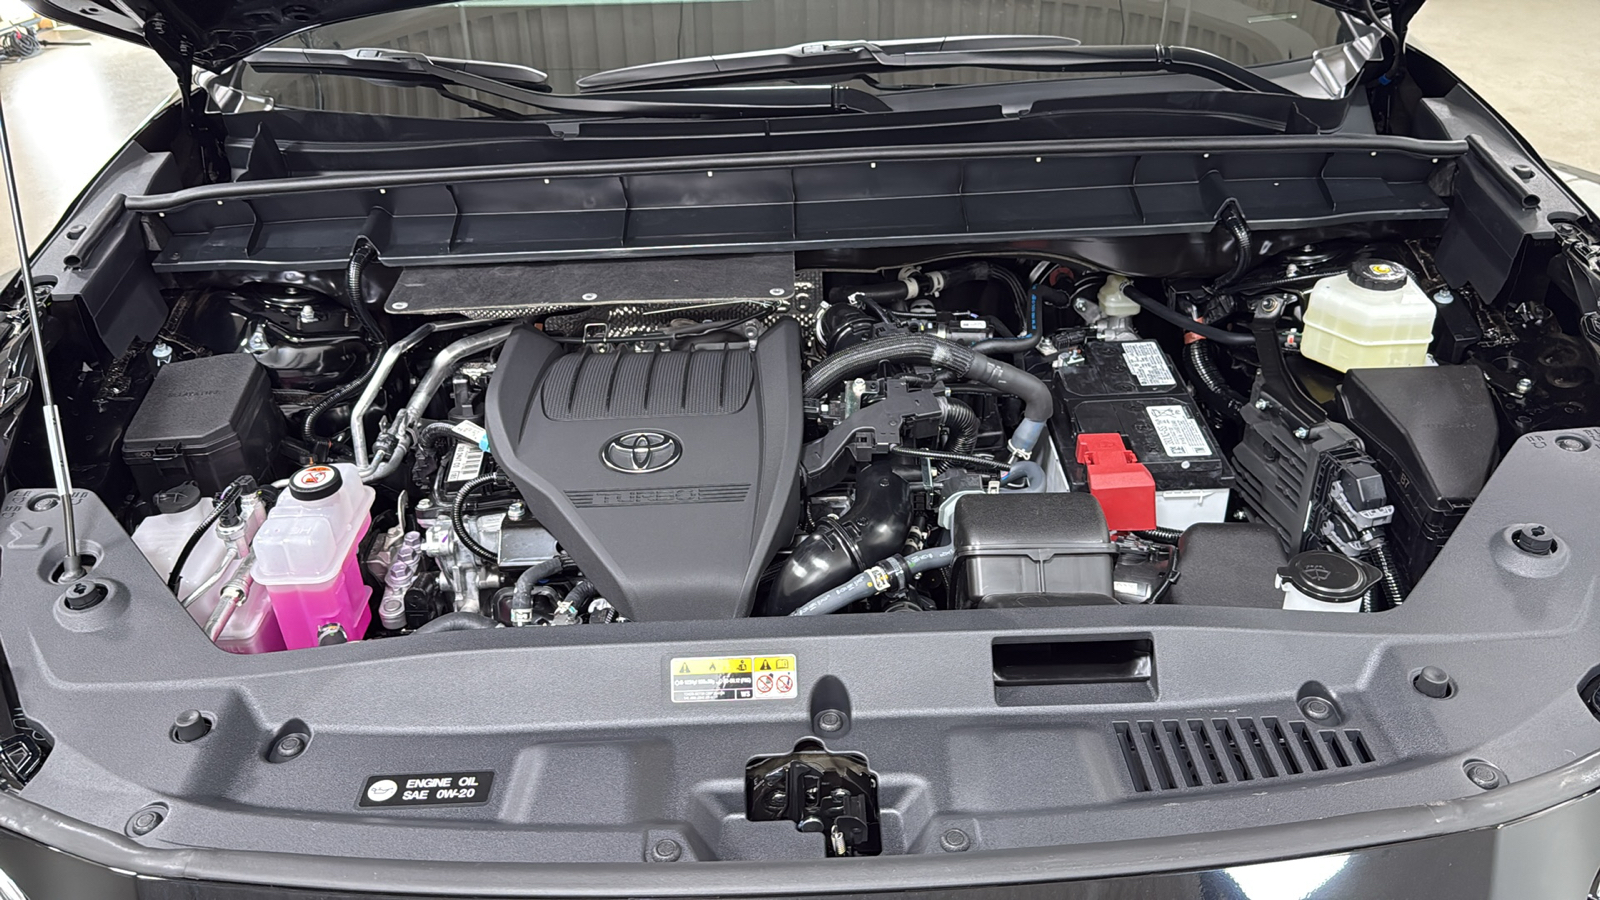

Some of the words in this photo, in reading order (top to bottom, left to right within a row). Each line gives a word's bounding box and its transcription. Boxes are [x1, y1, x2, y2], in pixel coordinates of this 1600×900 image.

[596, 489, 699, 503] TURBO
[405, 778, 452, 788] ENGINE
[458, 777, 478, 787] OIL
[402, 790, 429, 800] SAE
[436, 788, 475, 798] 0W-20
